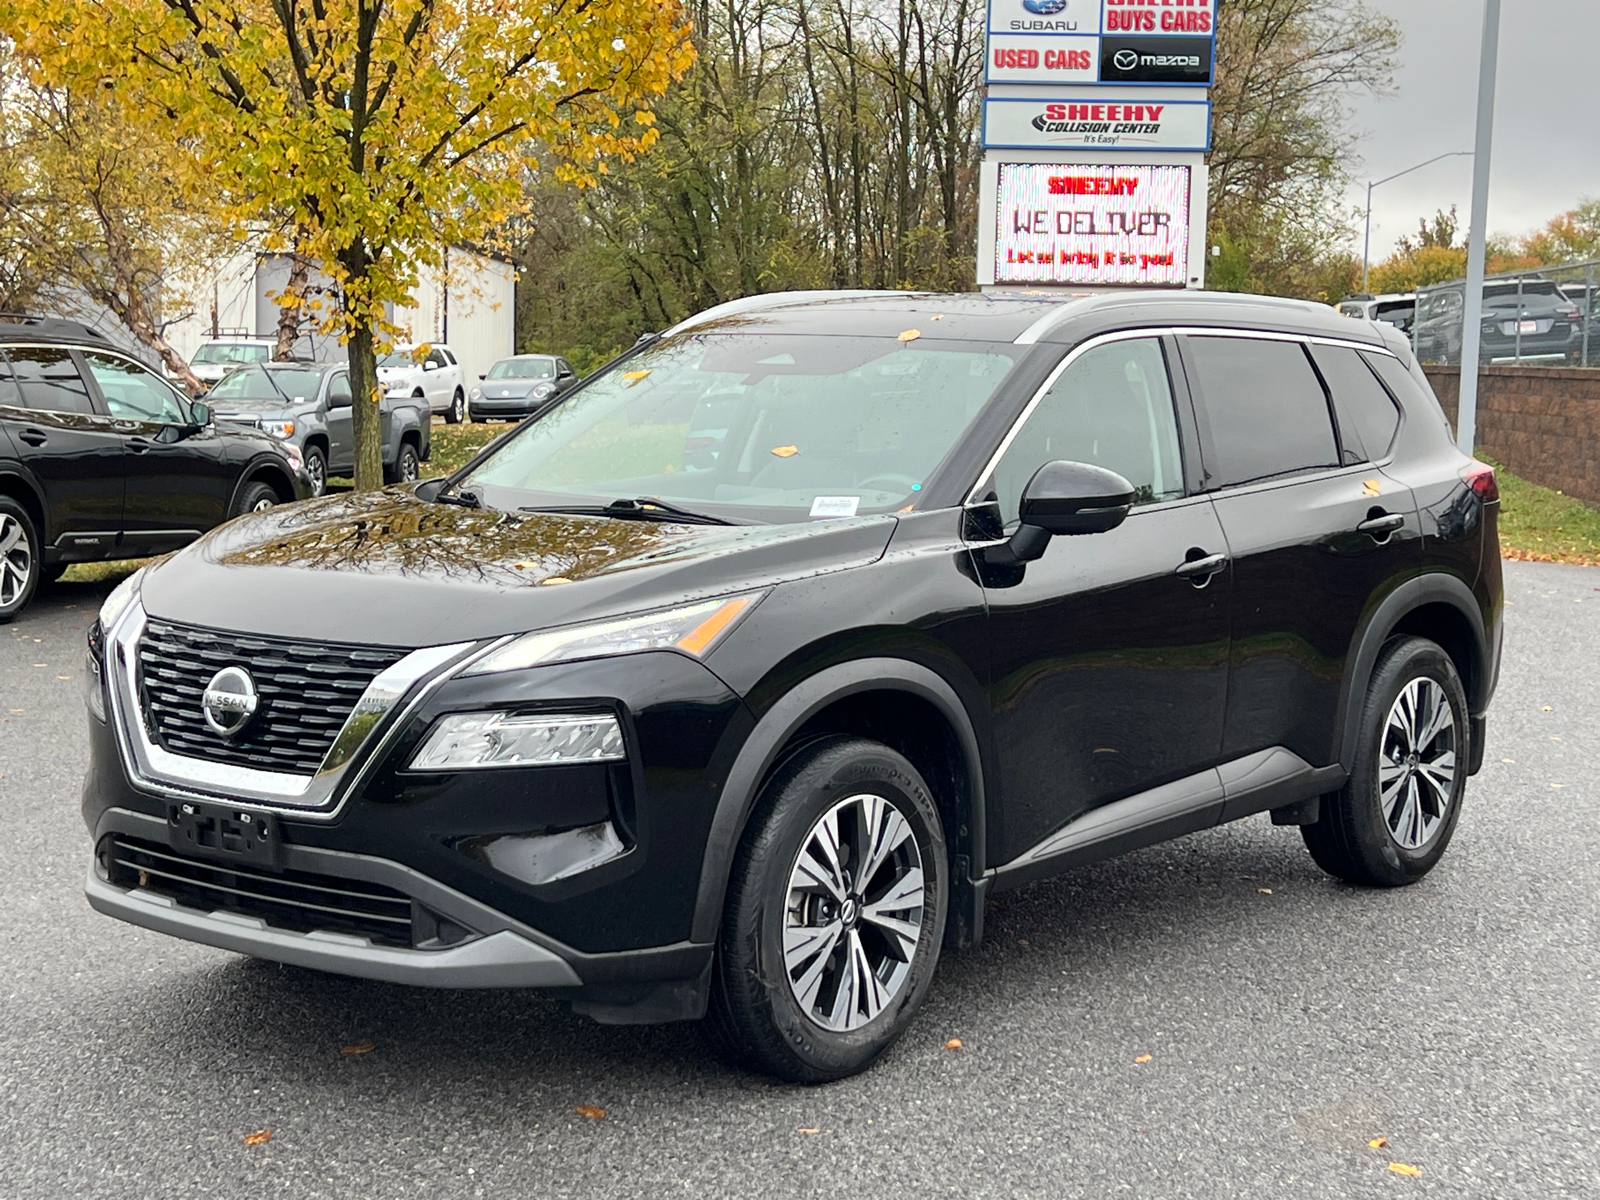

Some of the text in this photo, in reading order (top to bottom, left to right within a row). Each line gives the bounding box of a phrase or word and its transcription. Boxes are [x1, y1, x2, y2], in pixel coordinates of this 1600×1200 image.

[1010, 20, 1077, 31] SUBARU
[1107, 10, 1211, 33] BUYS CARS
[994, 48, 1091, 70] USED CARS
[1140, 55, 1200, 67] mazda
[1046, 104, 1164, 121] SHEEHY
[1046, 122, 1161, 134] COLLISION CENTER
[1083, 134, 1119, 145] It's Easy!
[1014, 210, 1171, 235] WE DELIVER
[205, 693, 248, 709] NISSAN
